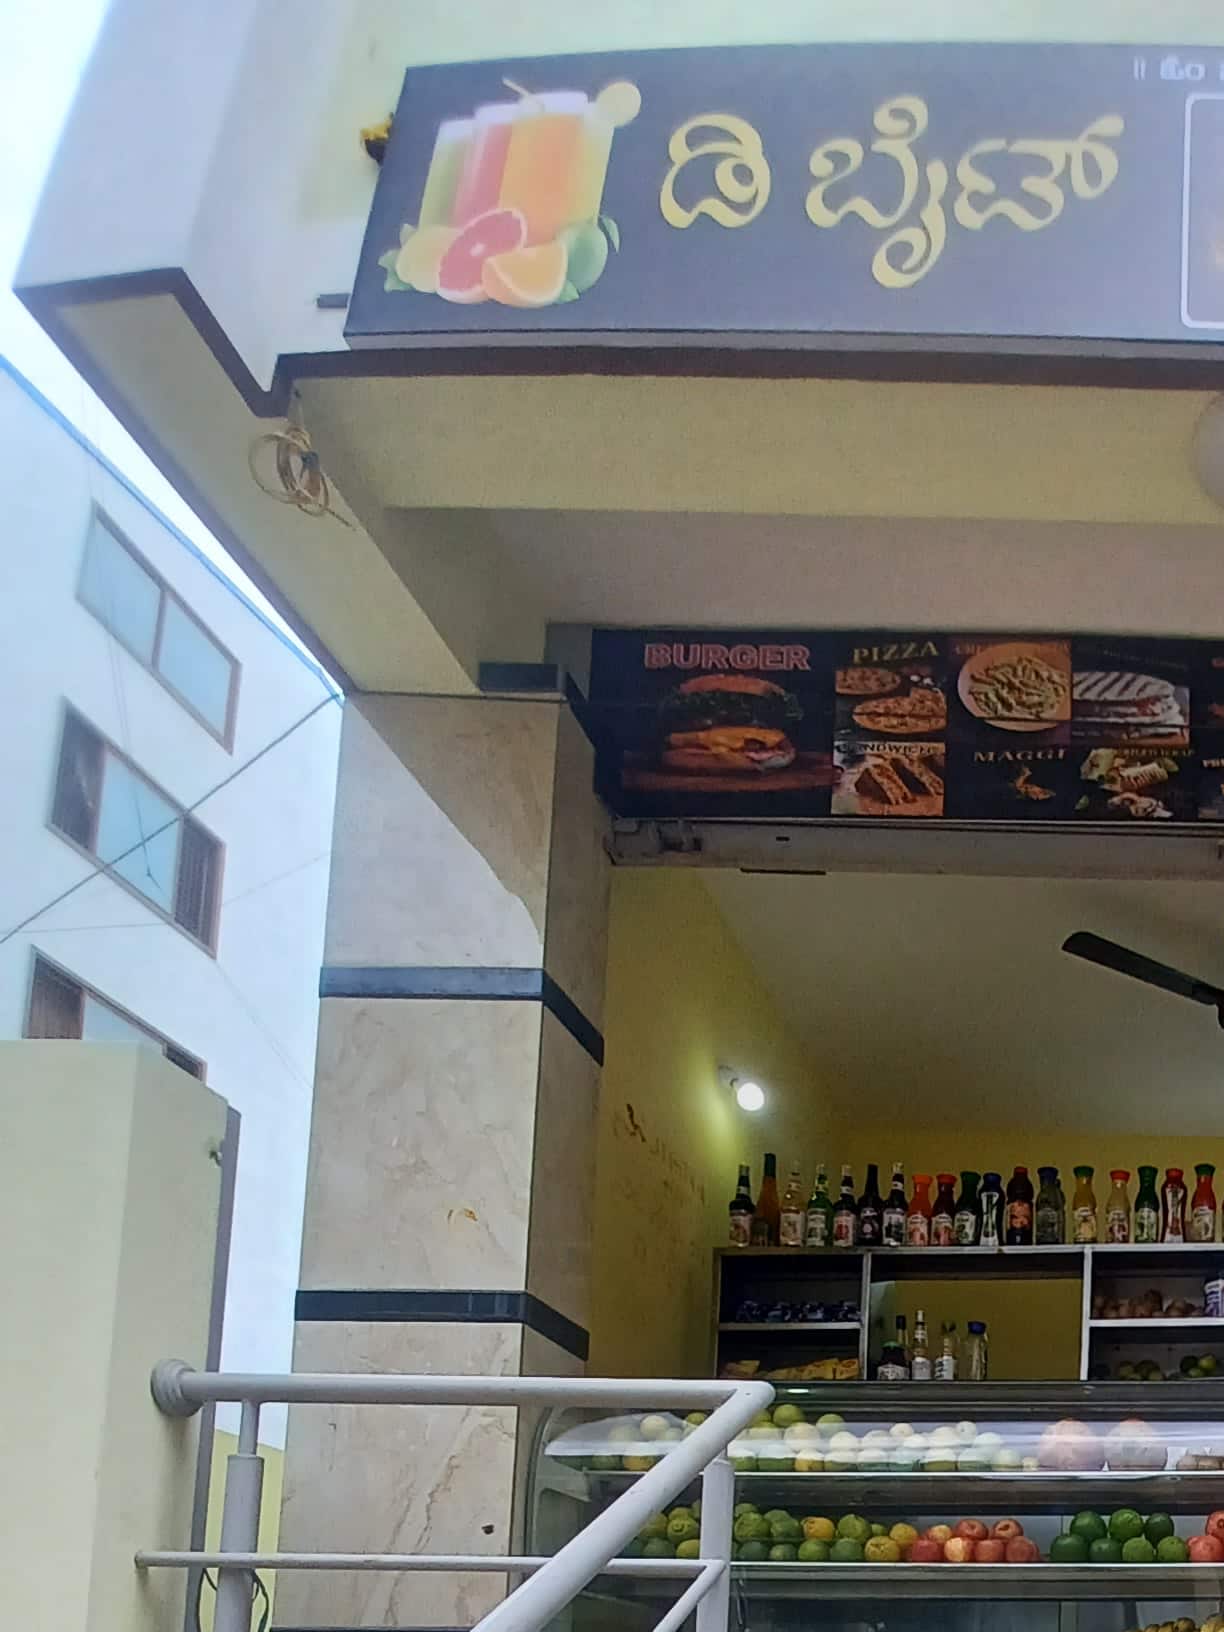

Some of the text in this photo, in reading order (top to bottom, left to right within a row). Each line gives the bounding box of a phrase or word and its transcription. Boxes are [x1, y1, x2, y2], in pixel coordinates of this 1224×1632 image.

[659, 94, 1126, 290] ಡಿ ಬೈಟ್
[643, 643, 811, 671] BURGER
[852, 639, 940, 665] PIZZA
[972, 749, 1068, 765] MAGGI
